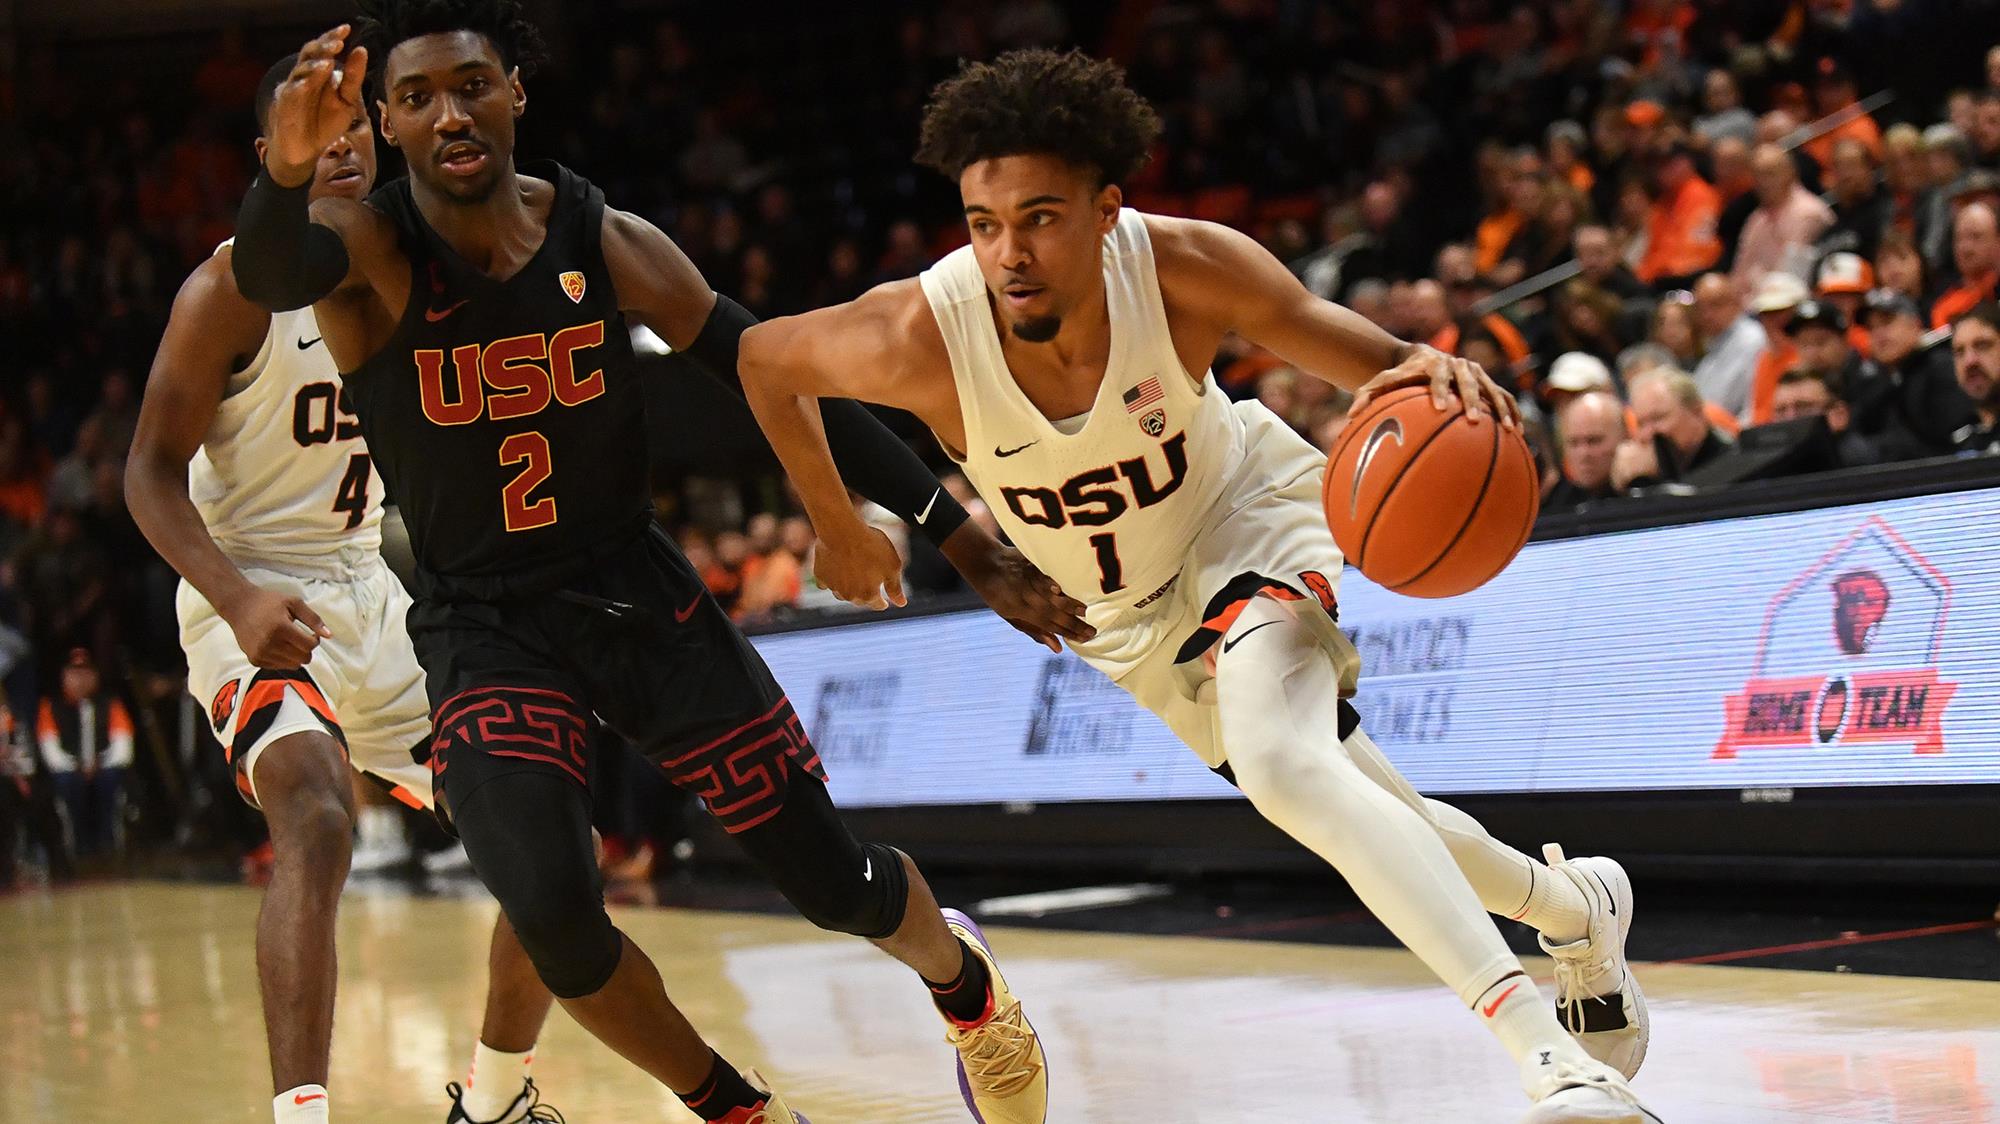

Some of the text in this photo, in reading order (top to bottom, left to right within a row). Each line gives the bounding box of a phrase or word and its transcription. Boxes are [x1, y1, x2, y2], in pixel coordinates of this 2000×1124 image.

[415, 320, 605, 425] USC
[293, 381, 363, 447] OS
[331, 453, 371, 530] 4
[499, 430, 557, 532] 2
[999, 430, 1188, 530] OSU
[1089, 531, 1128, 596] 1
[1856, 684, 1929, 730] TEAM
